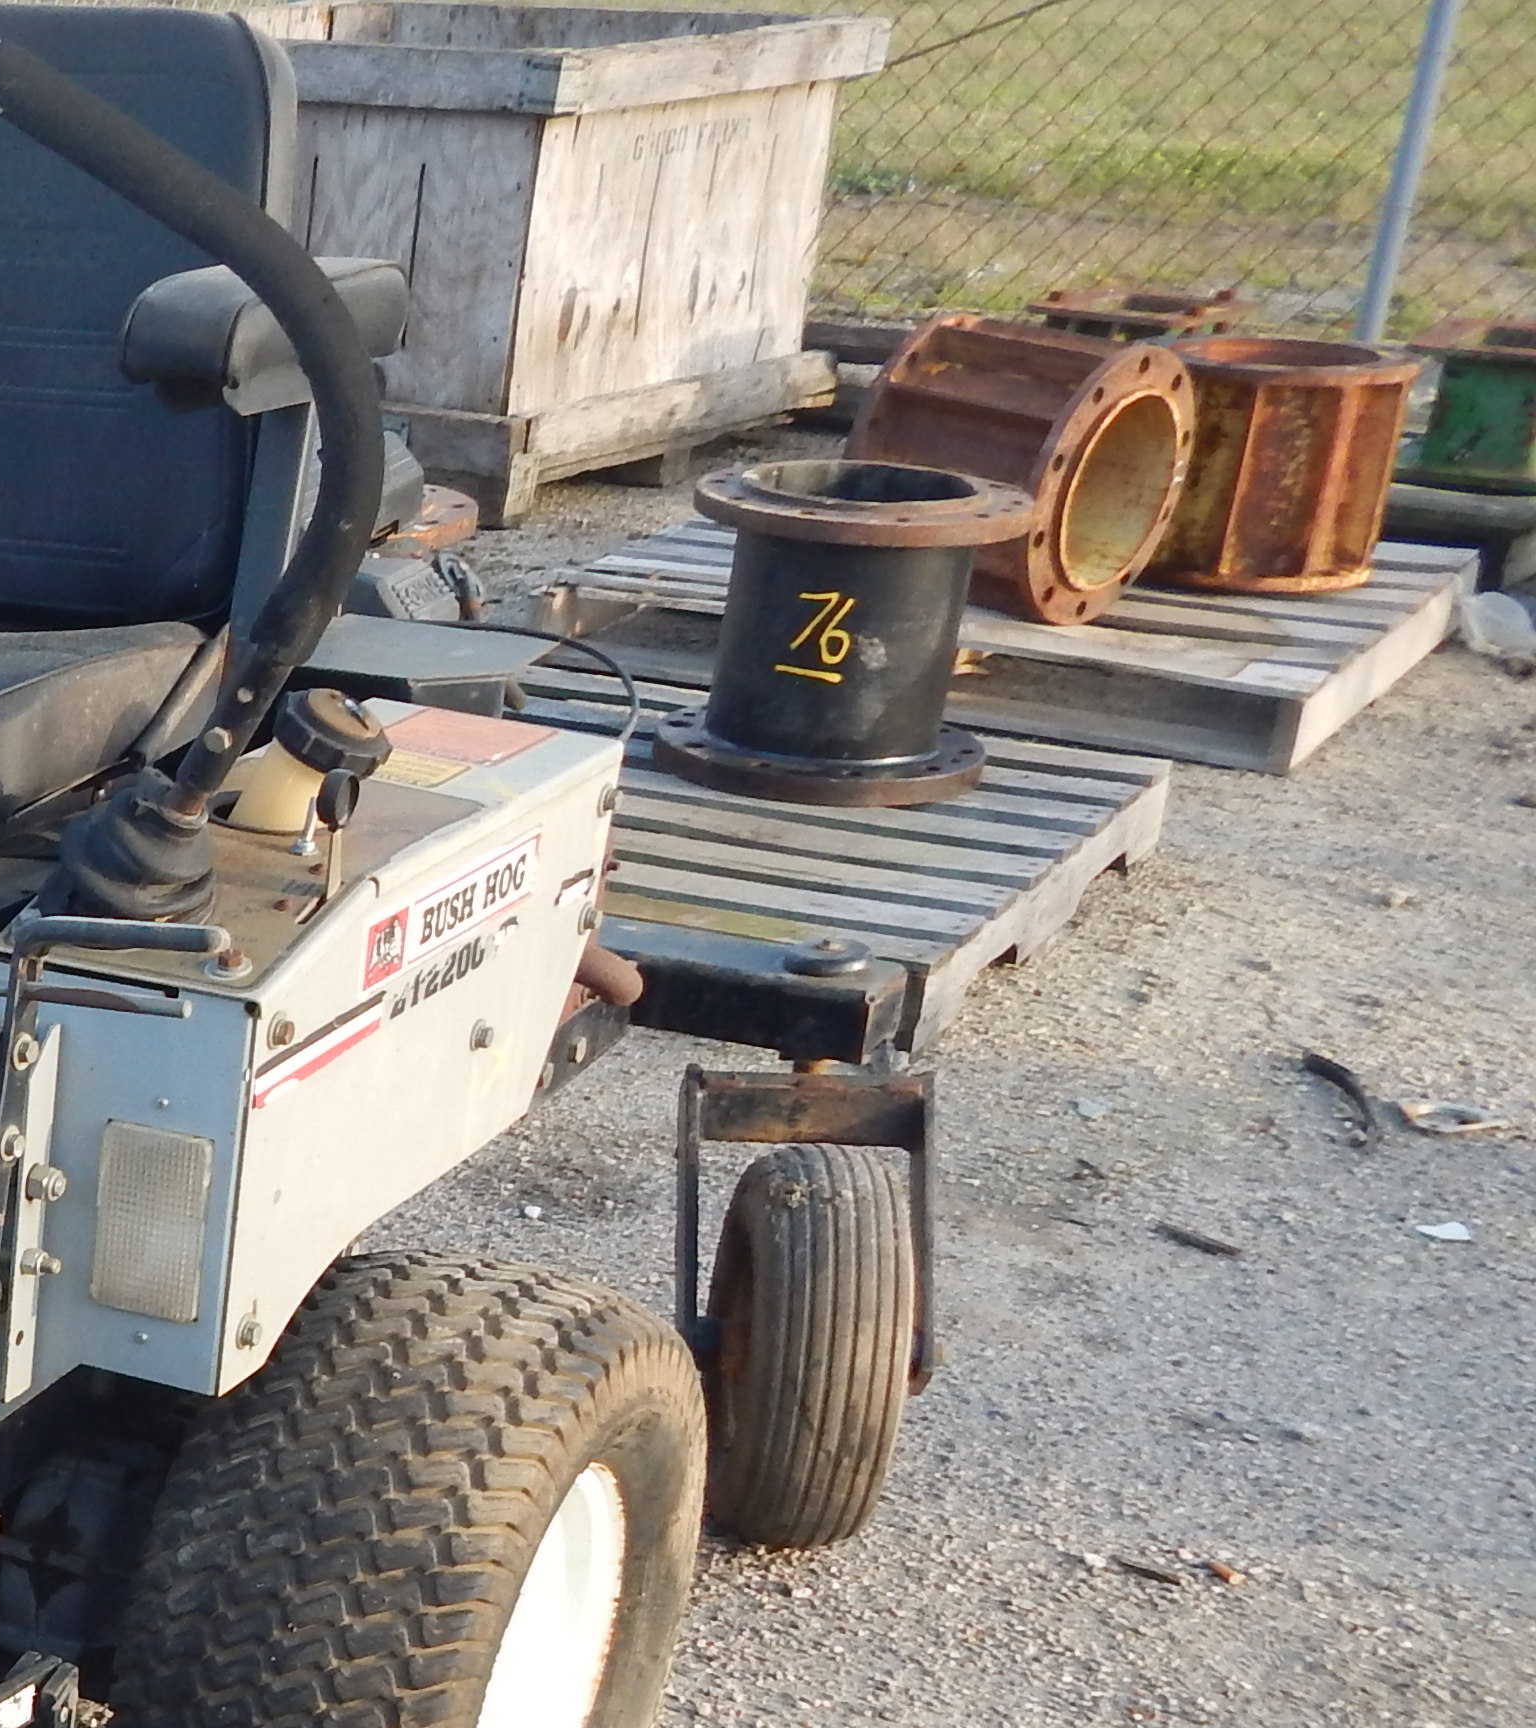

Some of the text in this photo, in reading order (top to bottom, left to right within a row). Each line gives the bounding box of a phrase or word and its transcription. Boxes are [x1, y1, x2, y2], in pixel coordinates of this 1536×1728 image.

[790, 591, 857, 665] 76
[419, 854, 528, 945] BUSH HOG
